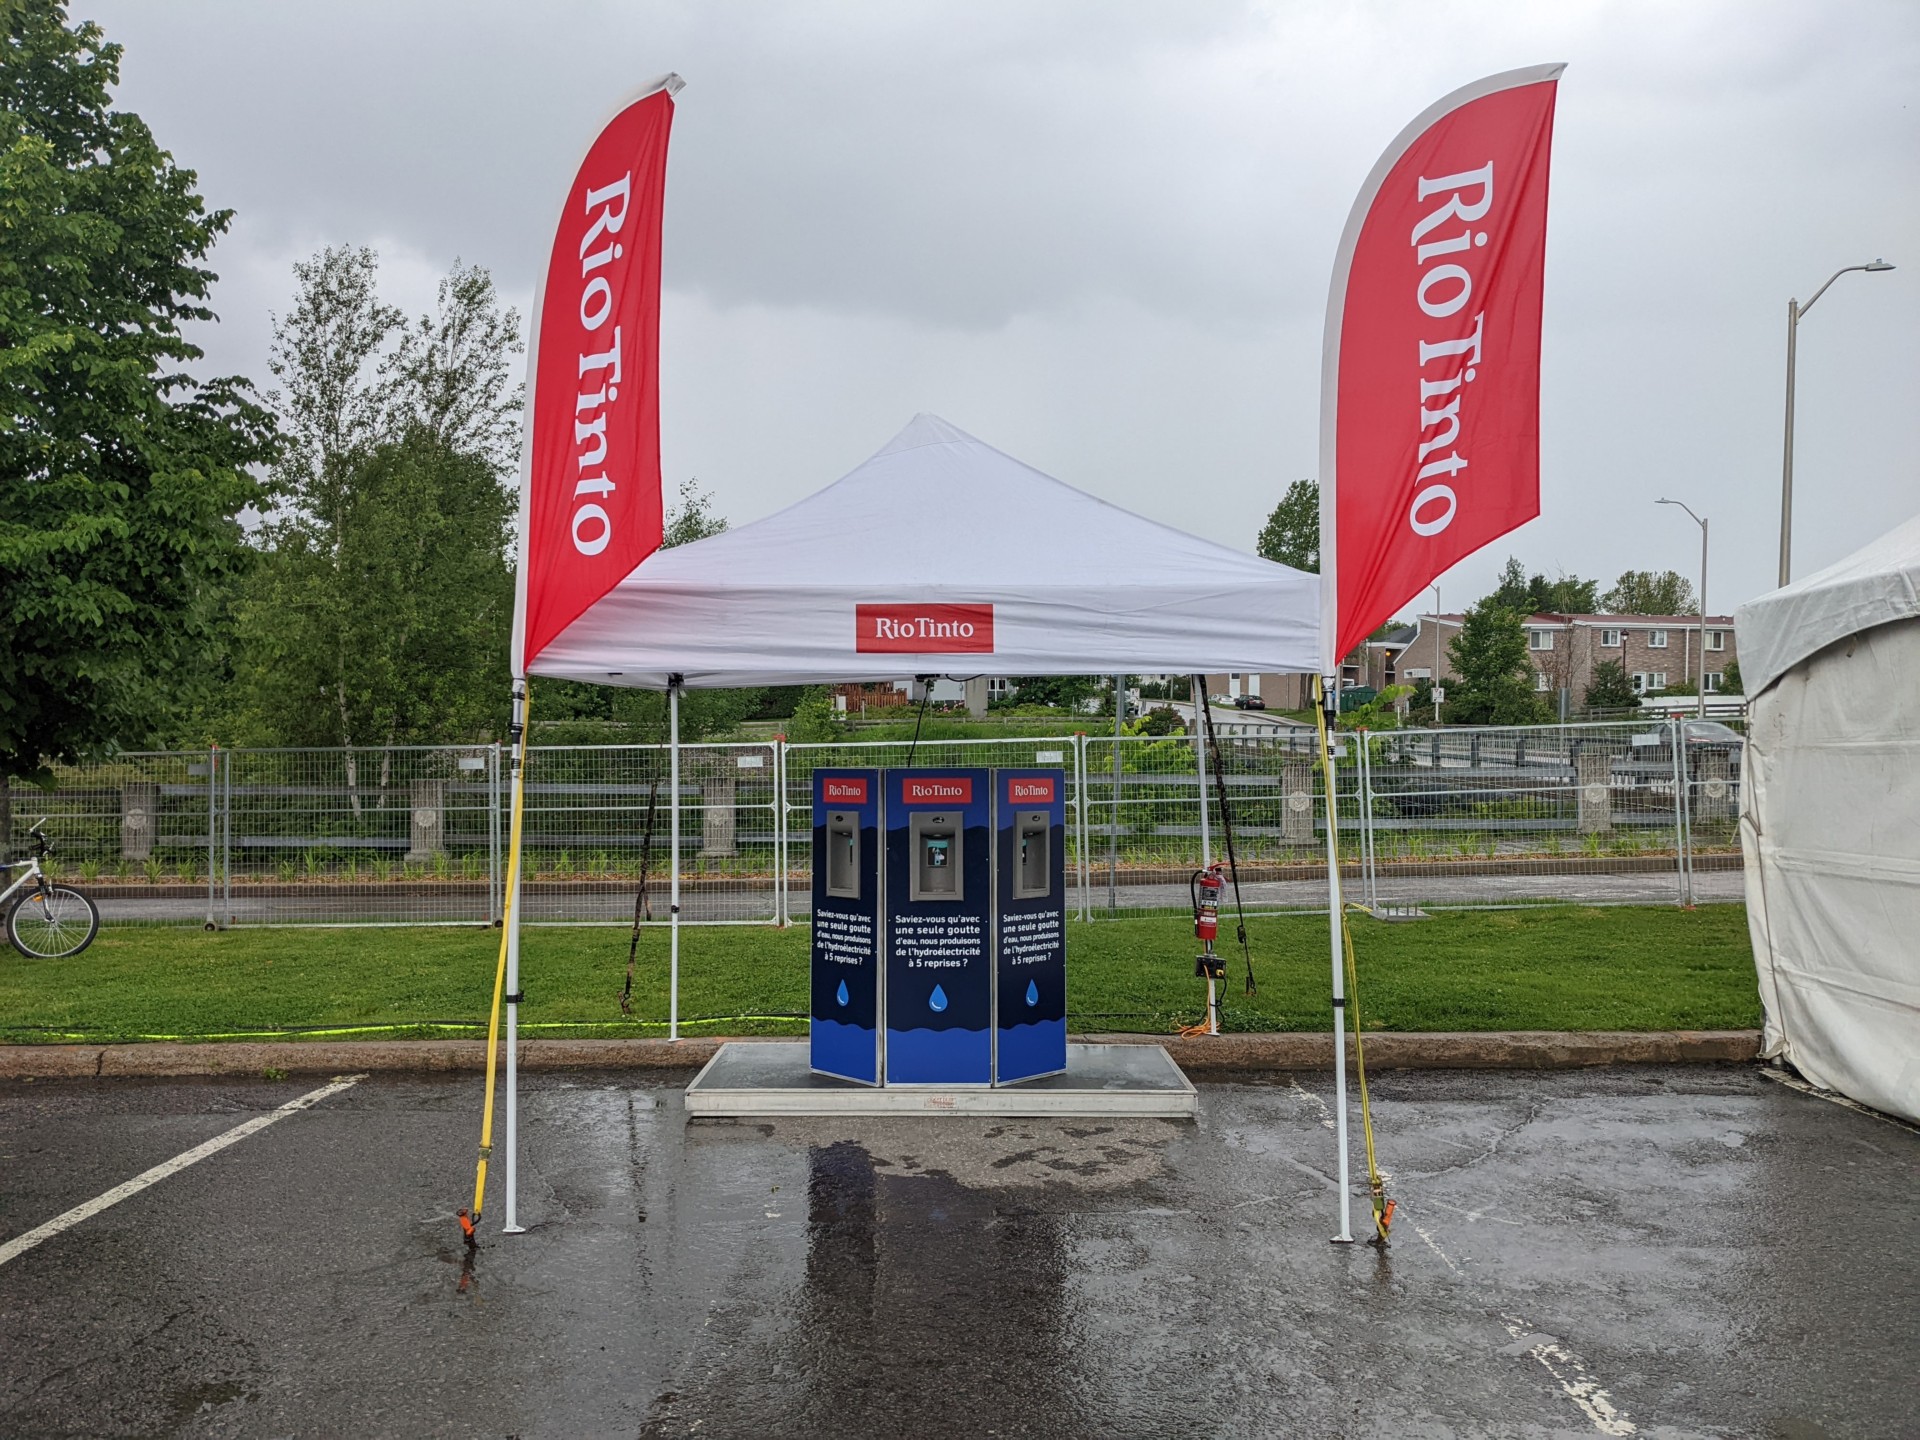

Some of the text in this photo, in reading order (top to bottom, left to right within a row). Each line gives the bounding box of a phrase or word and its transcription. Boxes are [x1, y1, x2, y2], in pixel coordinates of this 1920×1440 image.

[817, 909, 849, 920] Saviez-vous
[895, 914, 981, 925] Saviez-vous qu'avec
[1003, 913, 1037, 923] Saviez-vous
[817, 920, 872, 934] une seule goutte
[895, 925, 981, 936] une seule goutte
[1003, 920, 1059, 934] une seule goutte
[831, 933, 844, 941] nous
[844, 934, 871, 945] produisons
[895, 937, 919, 946] d'eau,
[939, 937, 981, 946] produisons
[1019, 934, 1032, 942] nous
[1032, 931, 1059, 942] produisons
[817, 940, 824, 949] de
[895, 947, 981, 958] de l'hydroélectricité
[1003, 946, 1011, 955] de
[829, 952, 834, 961] 5
[834, 954, 858, 964] reprises
[1017, 955, 1022, 965] 5
[1022, 953, 1047, 965] reprises
[908, 958, 968, 970] à 5 reprises ?
